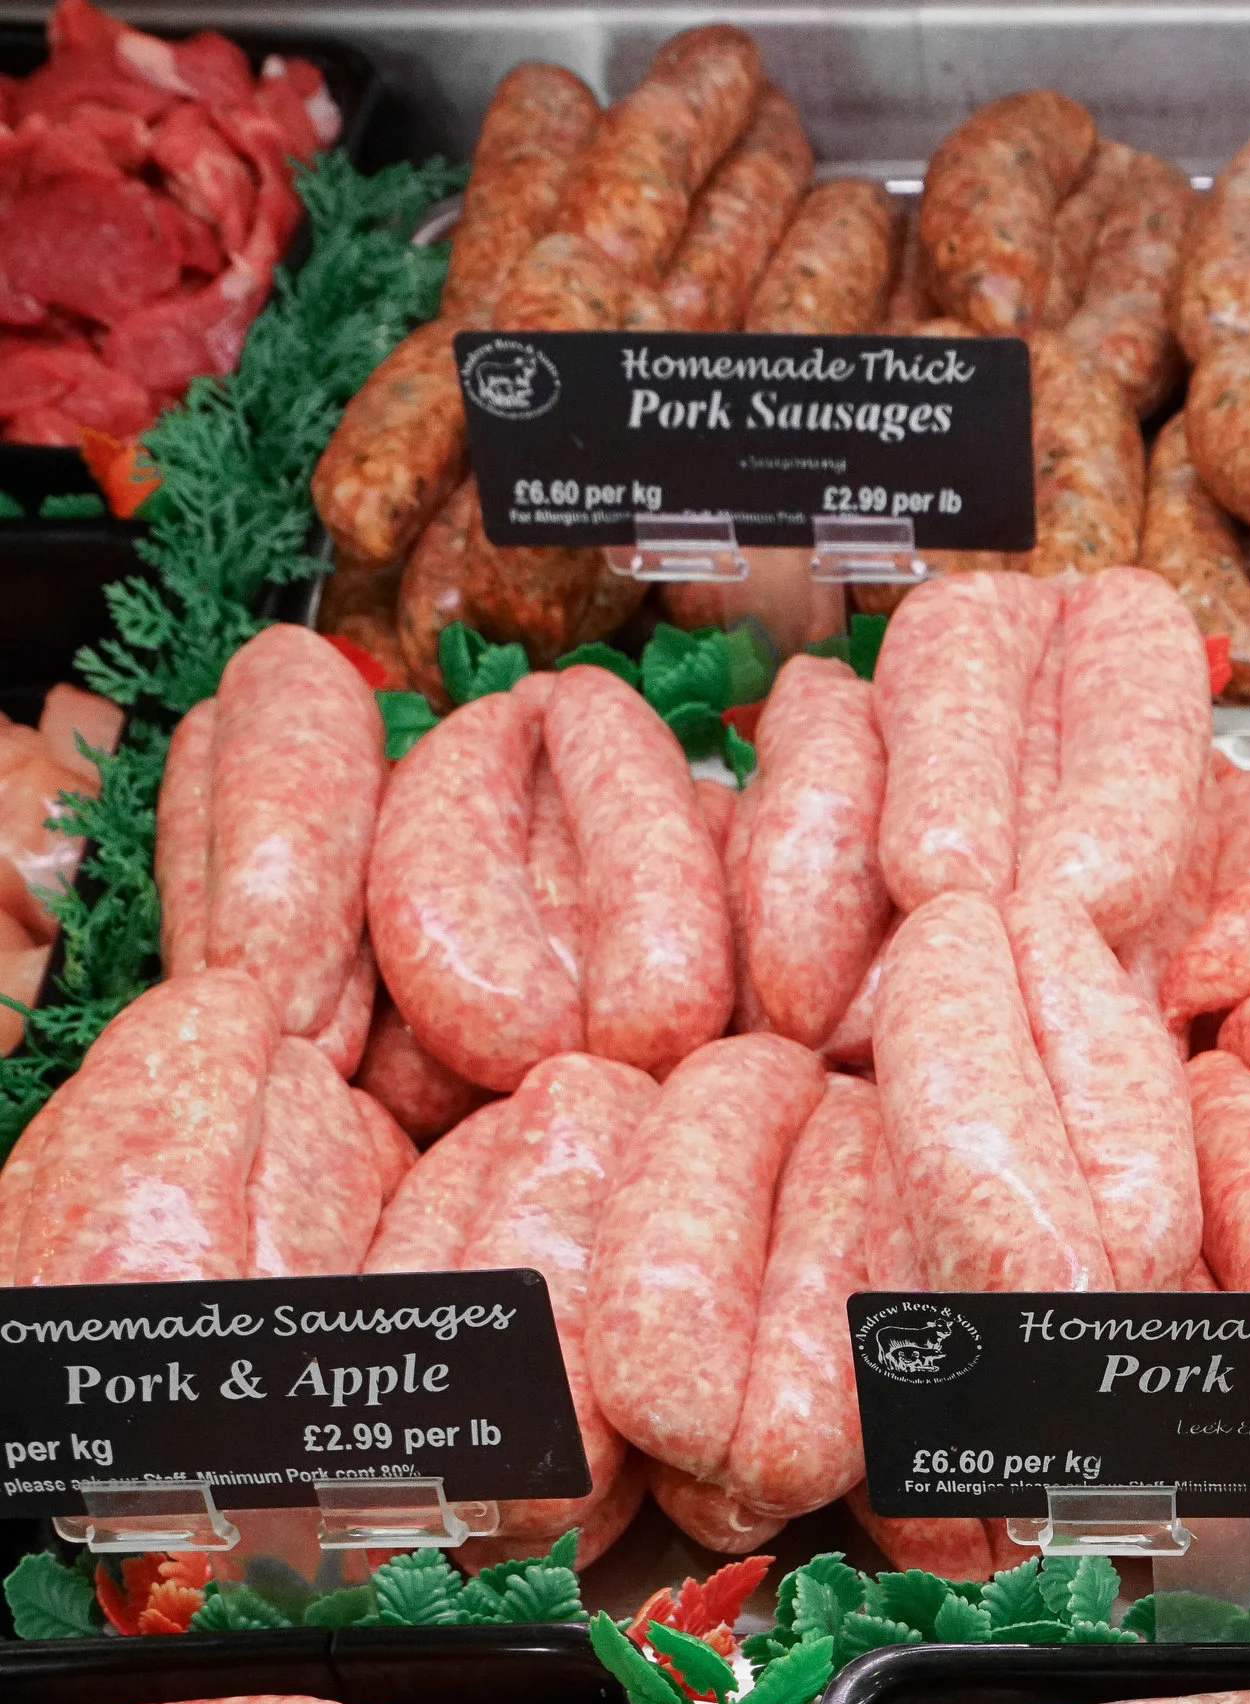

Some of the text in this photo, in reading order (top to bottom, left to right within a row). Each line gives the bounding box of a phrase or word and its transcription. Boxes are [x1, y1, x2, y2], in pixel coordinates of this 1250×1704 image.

[622, 348, 975, 384] Homemade Thick
[629, 390, 952, 441] Pork Sausages
[514, 479, 662, 511] £6.60 per kg
[823, 487, 961, 520] £2.99 per lb
[1, 1304, 516, 1343] omemade Sausages
[855, 1301, 982, 1342] Andrew Rees & Sons
[64, 1353, 449, 1407] Pork & Apple
[1099, 1355, 1234, 1393] Pork
[304, 1419, 501, 1454] £2.99 per lb
[1176, 1418, 1233, 1435] Leek
[5, 1434, 113, 1468] per kg
[912, 1449, 1102, 1479] £6.60 per kg
[4, 1477, 66, 1496] please
[196, 1470, 283, 1486] Minimum
[286, 1468, 329, 1483] Pork
[905, 1480, 931, 1493] For
